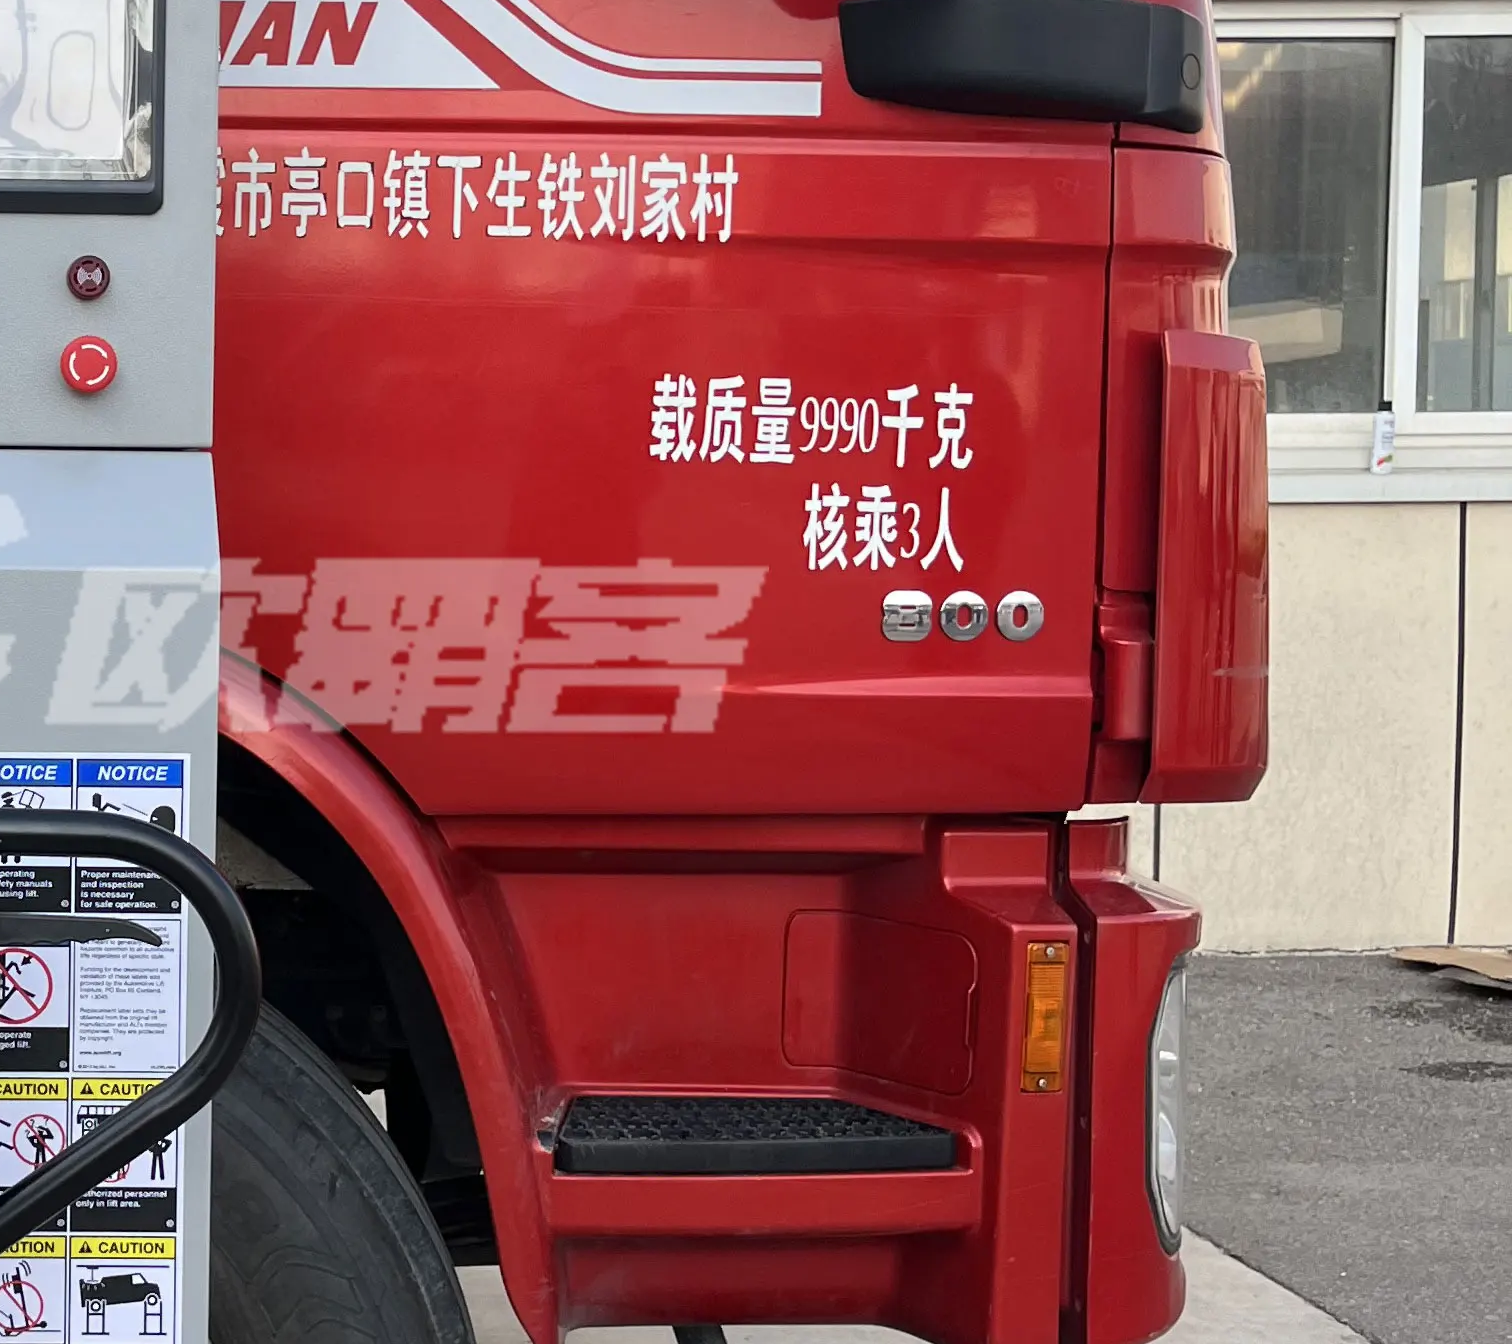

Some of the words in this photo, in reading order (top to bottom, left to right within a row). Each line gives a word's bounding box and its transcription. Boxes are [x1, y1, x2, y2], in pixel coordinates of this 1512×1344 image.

[649, 373, 975, 470] 载质量9990千克
[803, 482, 964, 572] 核乘3人
[97, 765, 169, 782] NOTICE
[81, 870, 110, 880] Proper
[81, 880, 97, 888] and
[99, 880, 144, 890] inspection
[0, 890, 23, 899] using
[81, 890, 88, 898] is
[90, 890, 134, 900] necessary
[80, 900, 92, 908] for
[95, 900, 113, 908] safe
[115, 900, 158, 910] operation.
[0, 1032, 32, 1040] operate
[124, 1190, 167, 1199] personnel
[75, 1200, 93, 1209] only
[98, 1242, 165, 1254] CAUTION
